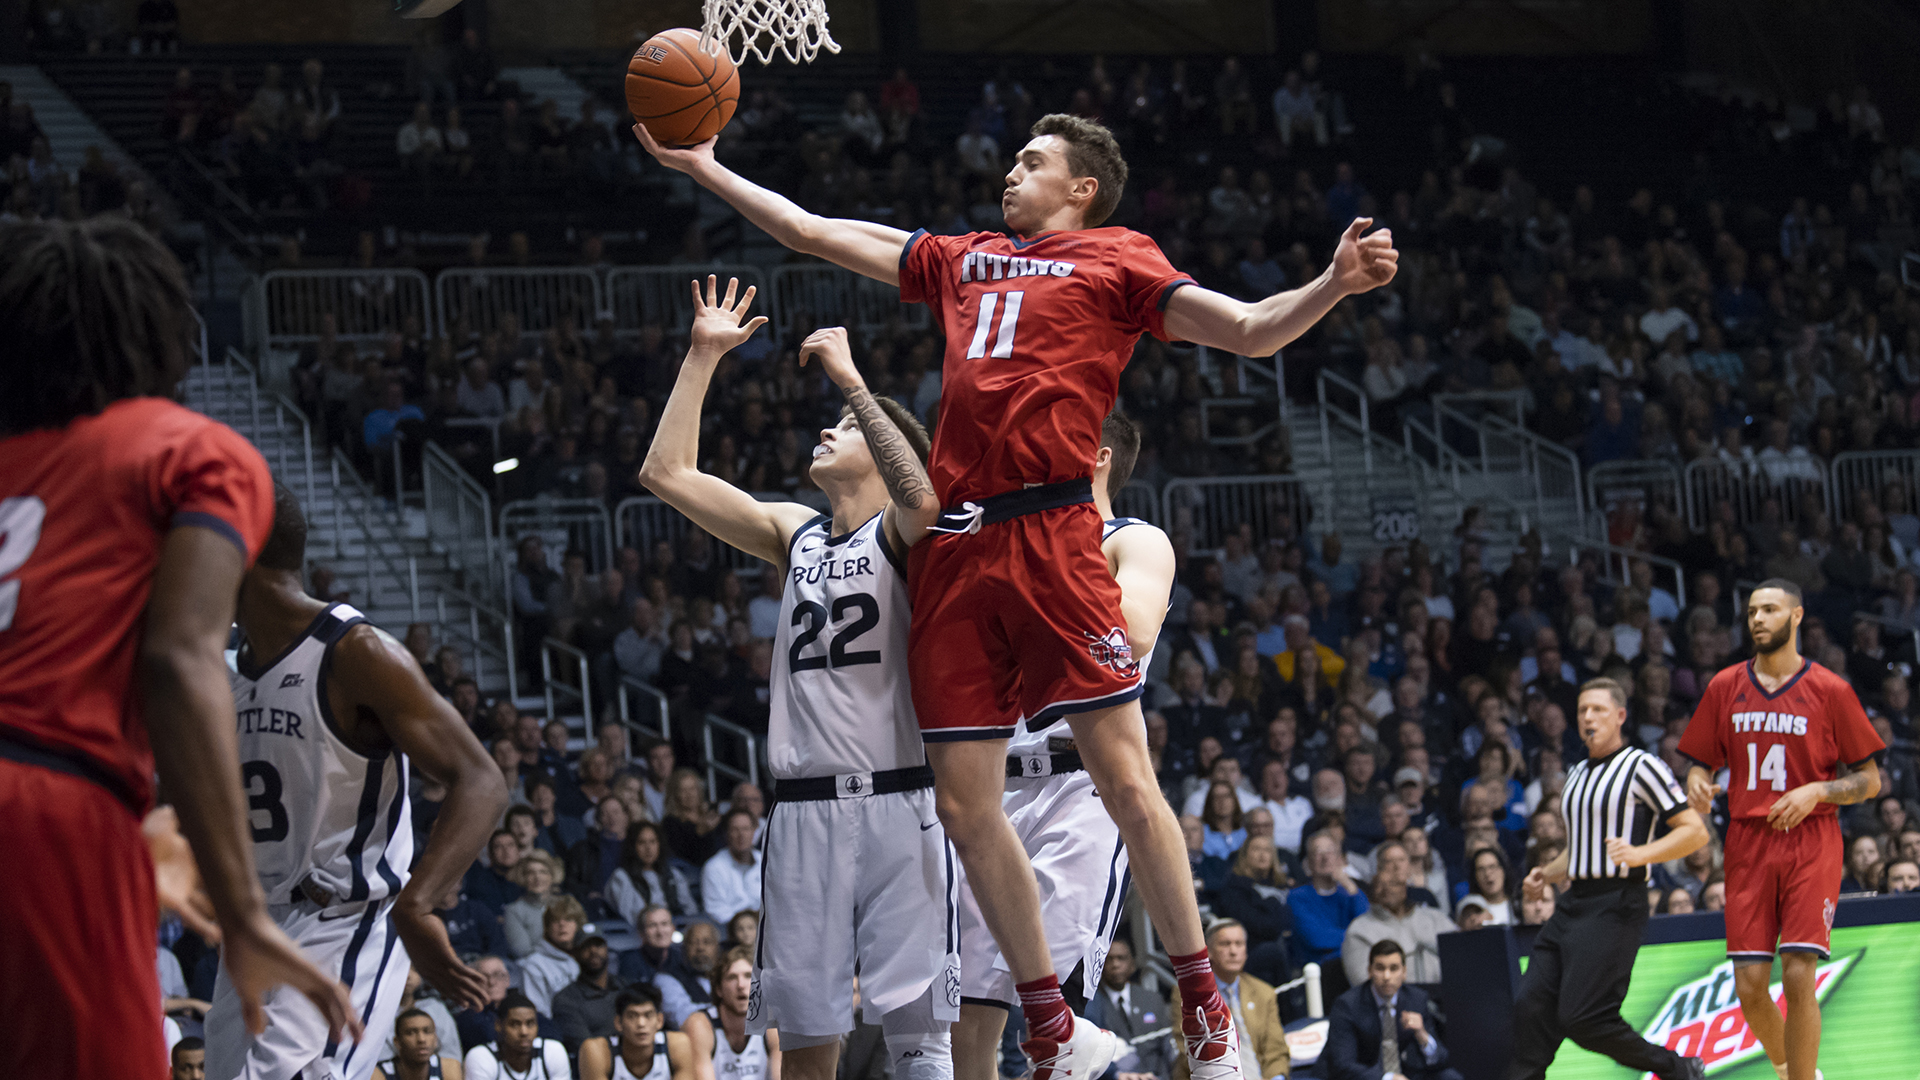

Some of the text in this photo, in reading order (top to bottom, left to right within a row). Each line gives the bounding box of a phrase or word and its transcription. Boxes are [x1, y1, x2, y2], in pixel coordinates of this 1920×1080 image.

[961, 251, 1077, 283] TITANS
[966, 290, 1025, 360] 11
[1374, 512, 1420, 540] 206
[793, 556, 874, 586] BUTLER
[789, 592, 881, 675] 22
[237, 707, 305, 740] TLER
[1731, 711, 1808, 737] TITANS
[1746, 742, 1787, 792] 14
